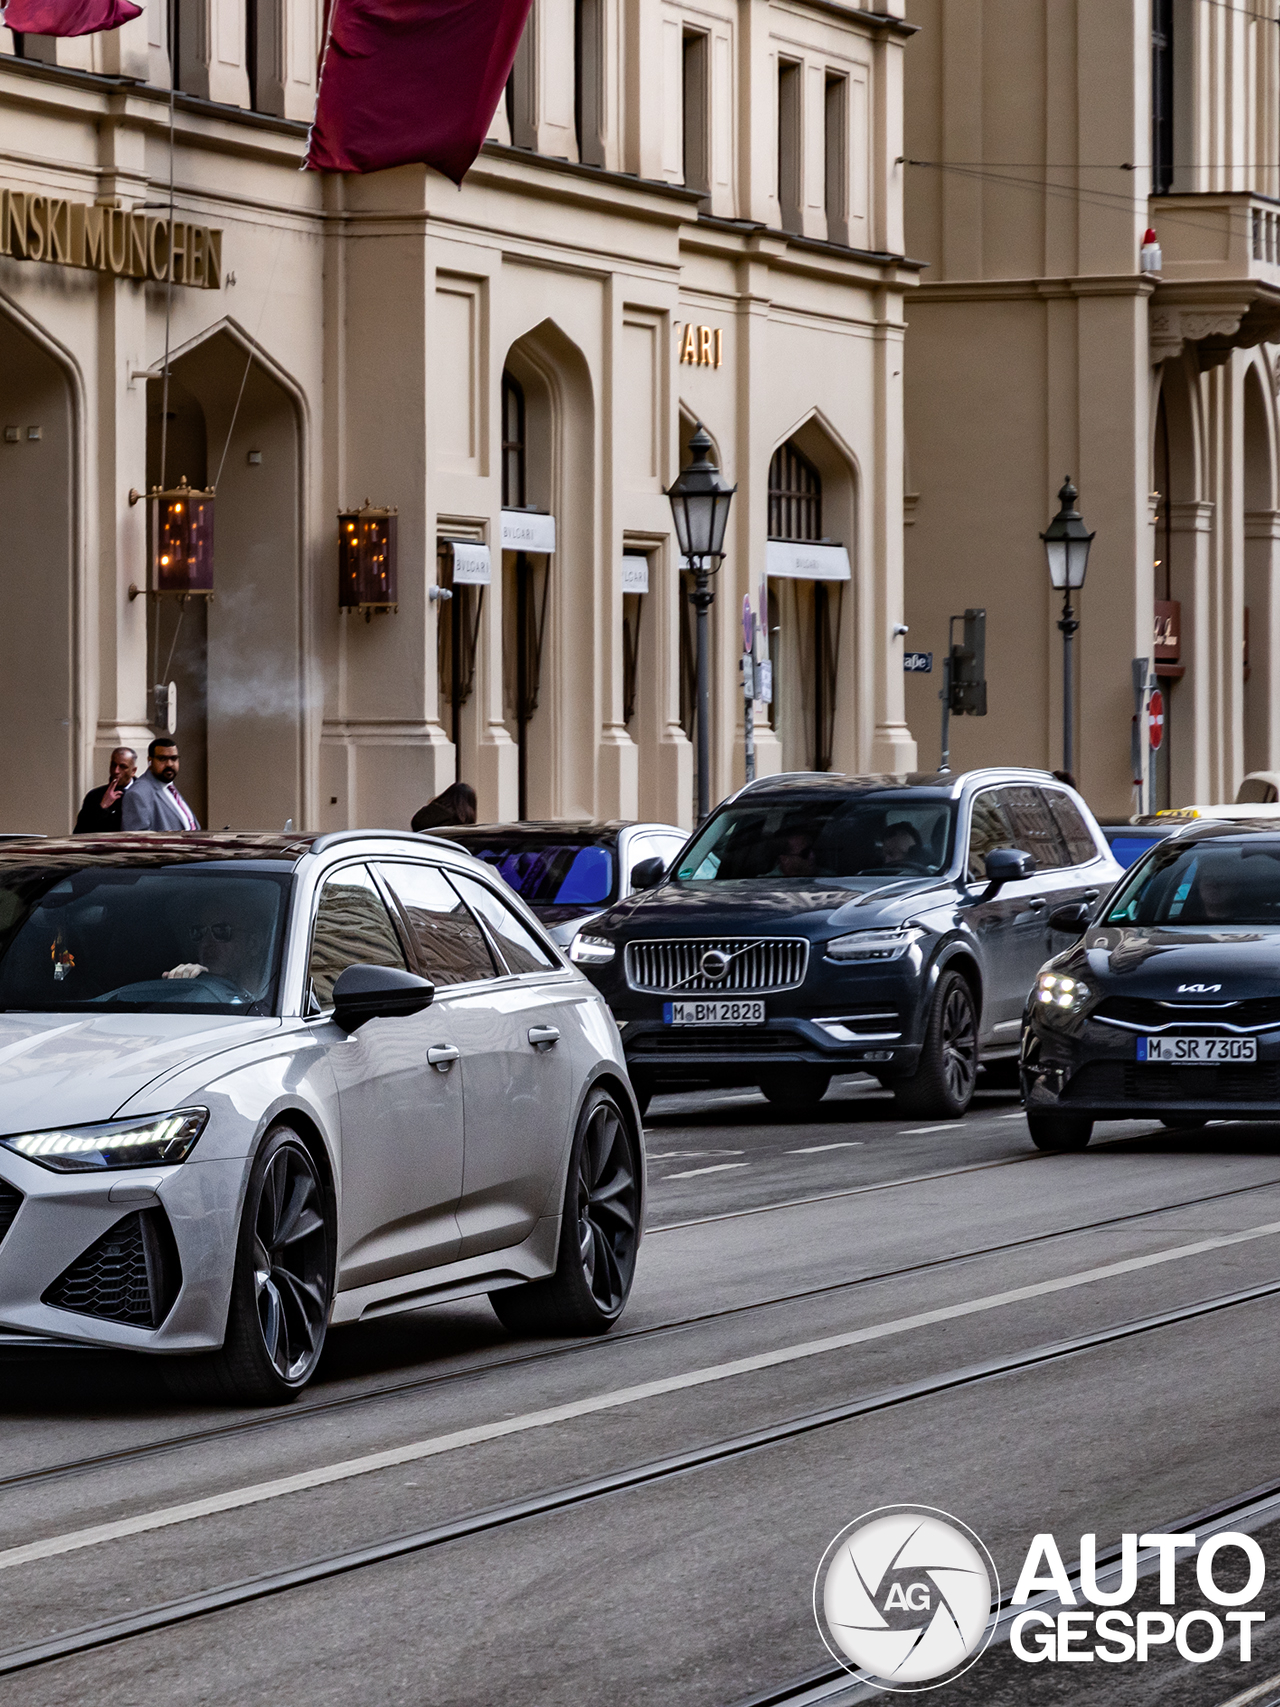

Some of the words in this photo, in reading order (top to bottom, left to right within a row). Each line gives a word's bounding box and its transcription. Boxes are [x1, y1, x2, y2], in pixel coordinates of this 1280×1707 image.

[80, 198, 222, 289] MÜNCHEN
[677, 323, 724, 368] ARI
[673, 1004, 685, 1020] M
[695, 1004, 717, 1020] BM
[720, 1003, 762, 1020] 2828
[1149, 1040, 1161, 1058] M
[1175, 1039, 1200, 1058] SR
[1205, 1040, 1255, 1059] 7305
